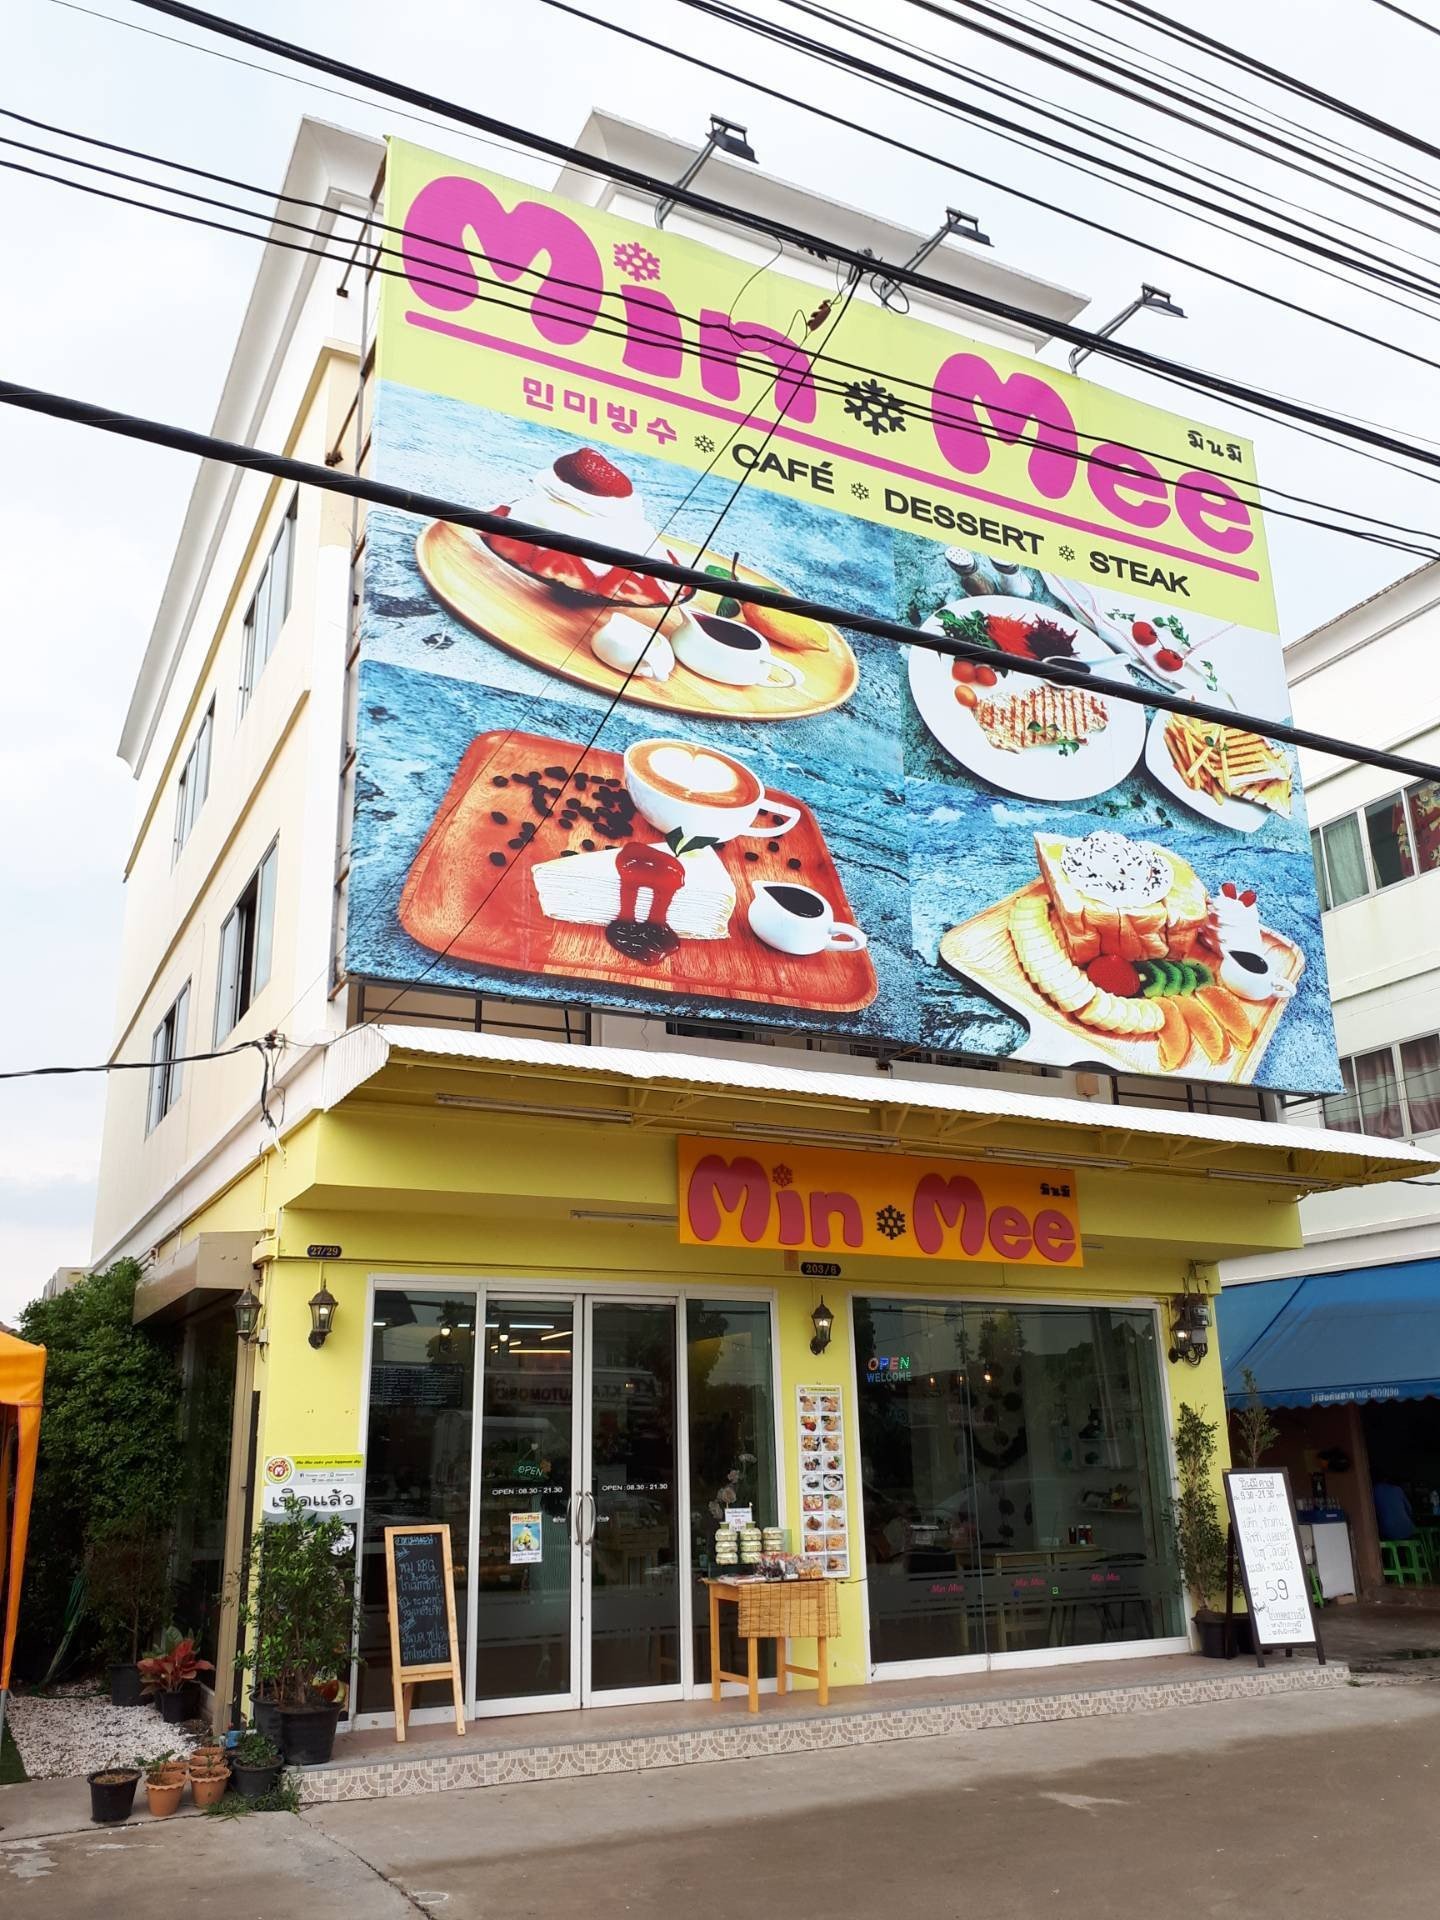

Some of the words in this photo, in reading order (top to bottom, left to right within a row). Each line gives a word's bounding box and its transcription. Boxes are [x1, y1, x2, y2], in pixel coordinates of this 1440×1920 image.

[402, 176, 816, 424] Min
[931, 353, 1254, 554] Mee
[522, 377, 678, 445] 민미빙수
[732, 444, 836, 494] CAFÉ
[885, 488, 1045, 555] DESSERT
[1089, 550, 1191, 597] STEAK
[687, 1154, 864, 1249] Min
[912, 1172, 1077, 1263] Mee
[867, 1355, 911, 1371] OPEN
[866, 1371, 913, 1383] WELCOME
[518, 1464, 543, 1477] OPEN
[491, 1488, 515, 1496] OPEN
[1265, 1578, 1289, 1602] 59
